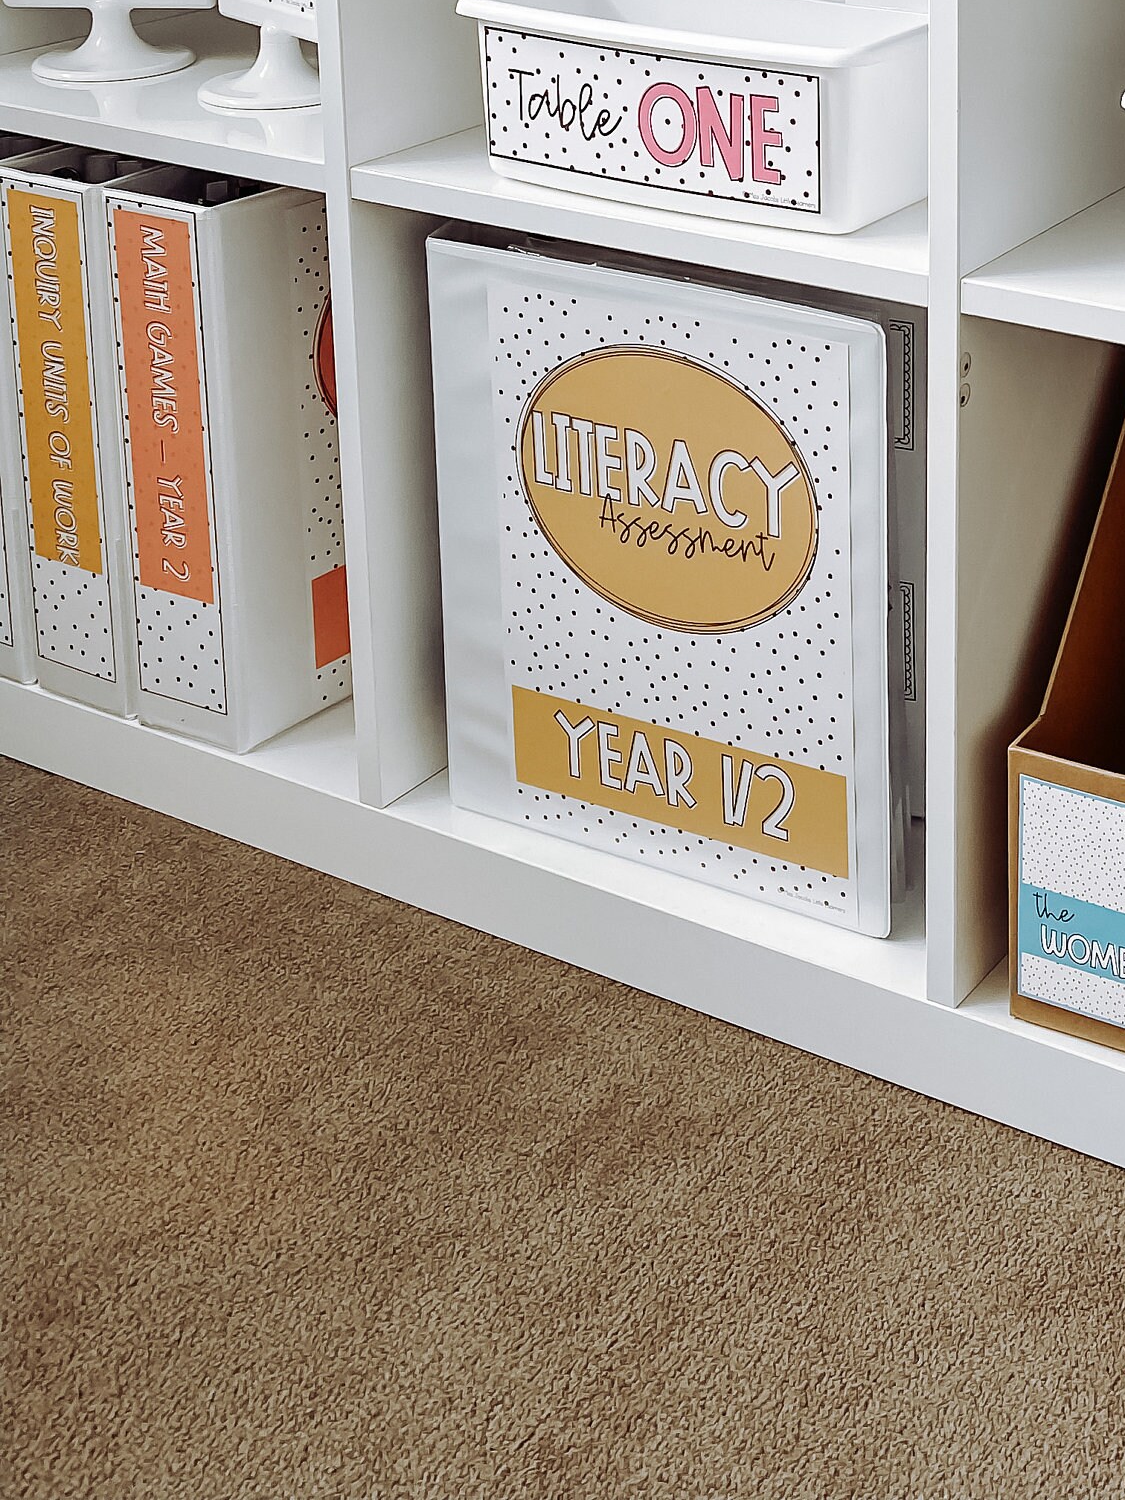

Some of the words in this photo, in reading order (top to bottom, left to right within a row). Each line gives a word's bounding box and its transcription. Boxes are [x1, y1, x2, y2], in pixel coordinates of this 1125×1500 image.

[508, 68, 623, 141] Table
[637, 81, 783, 186] ONE
[30, 203, 64, 332] INQUIRY
[138, 223, 173, 315] MATH
[40, 342, 70, 424] UNITS
[145, 320, 180, 435] GAMES
[47, 430, 73, 472] OF
[531, 410, 801, 540] LITERACY
[52, 478, 80, 566] WORK
[156, 475, 188, 550] YEAR
[599, 492, 777, 571] Assessment
[161, 561, 191, 583] 2
[552, 708, 699, 811] YEAR
[1032, 891, 1076, 923] the
